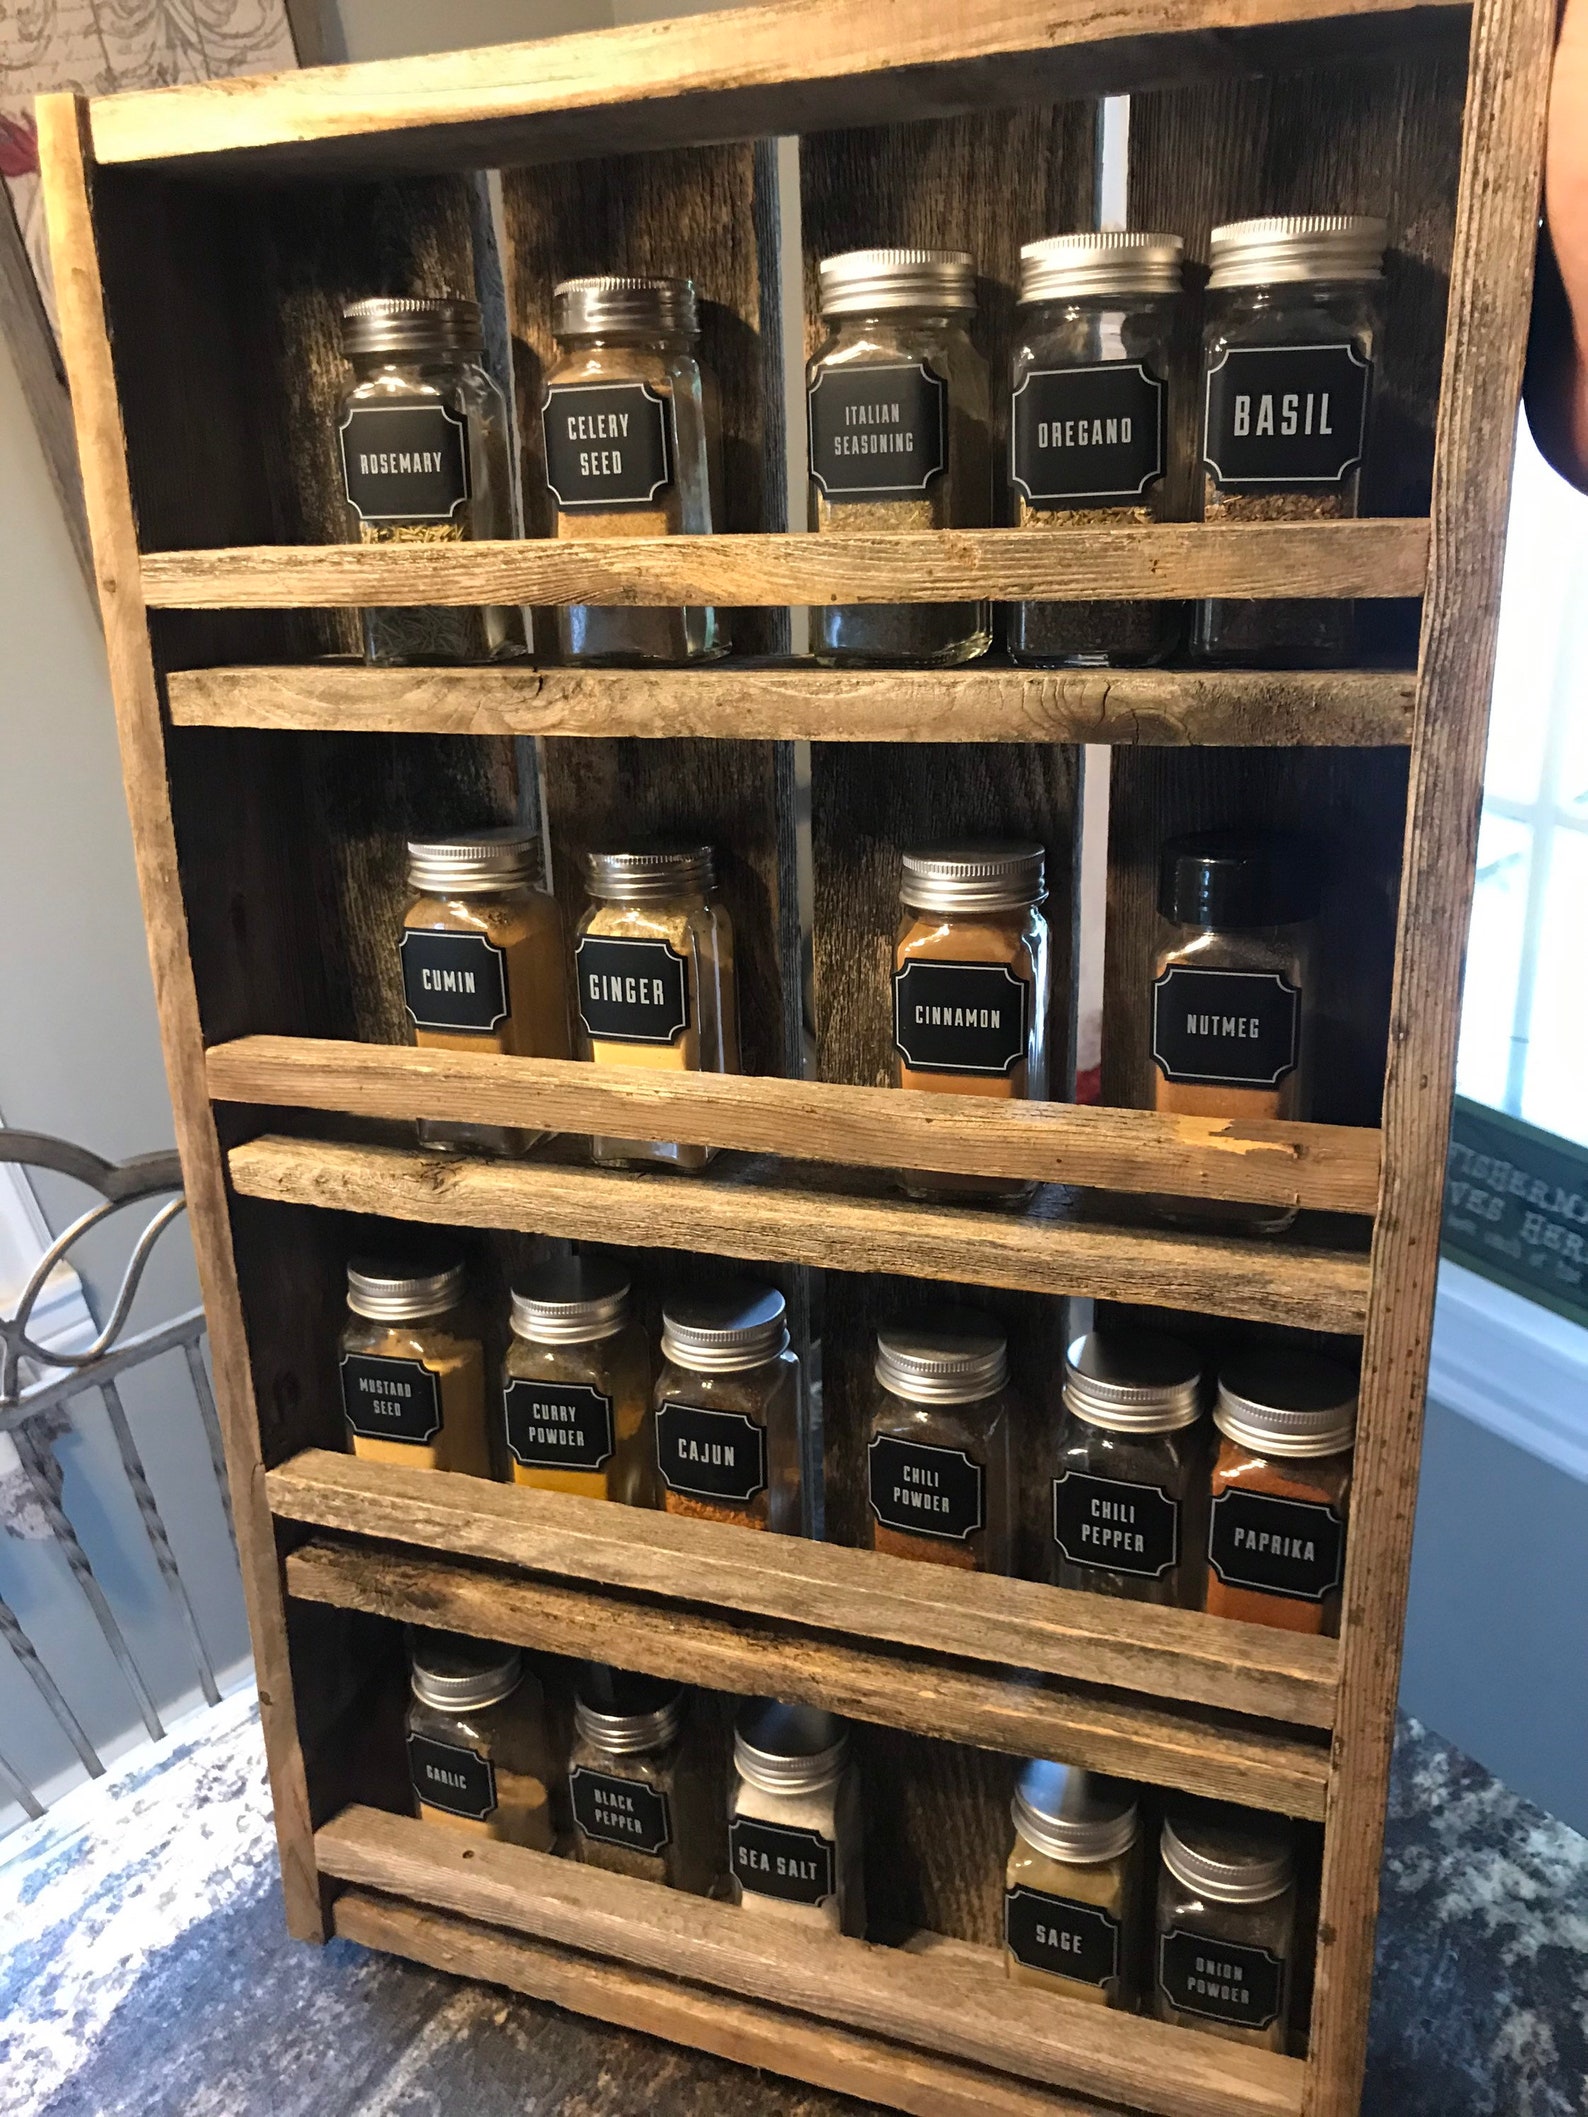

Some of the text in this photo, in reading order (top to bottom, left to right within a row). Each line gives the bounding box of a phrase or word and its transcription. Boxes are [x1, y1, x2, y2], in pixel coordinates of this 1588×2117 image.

[567, 413, 629, 441] CELERY
[845, 403, 900, 426] ITALIAN
[1233, 392, 1333, 437] BASIL
[834, 432, 914, 456] SEASONING
[1038, 417, 1133, 449] OREGANO
[360, 452, 442, 475] ROSEMARY
[580, 450, 622, 476] SEED
[422, 968, 476, 994] CUMIN
[589, 974, 665, 1006] GINGER
[915, 1005, 1001, 1030] CINNAMON
[1186, 1013, 1260, 1039] NUTMEG
[359, 1377, 412, 1399] MUSTARD
[373, 1399, 402, 1417] SEED
[532, 1403, 577, 1423] CURRY
[528, 1426, 585, 1447] POWDER
[678, 1437, 735, 1467] CAJUN
[903, 1465, 939, 1488] CHILI
[893, 1486, 950, 1514] POWDER
[1091, 1498, 1135, 1524] CHILI
[1081, 1524, 1144, 1553] PEPPER
[1234, 1527, 1315, 1562] PAPRIKA
[426, 1765, 467, 1790] GARLIC
[594, 1788, 633, 1812] BLACK
[595, 1808, 642, 1835] PEPPER
[738, 1846, 817, 1881] SEA SALT
[1035, 1924, 1083, 1955] SAGE
[1195, 1956, 1243, 1982] ONION
[1187, 1976, 1250, 2005] POWDER
